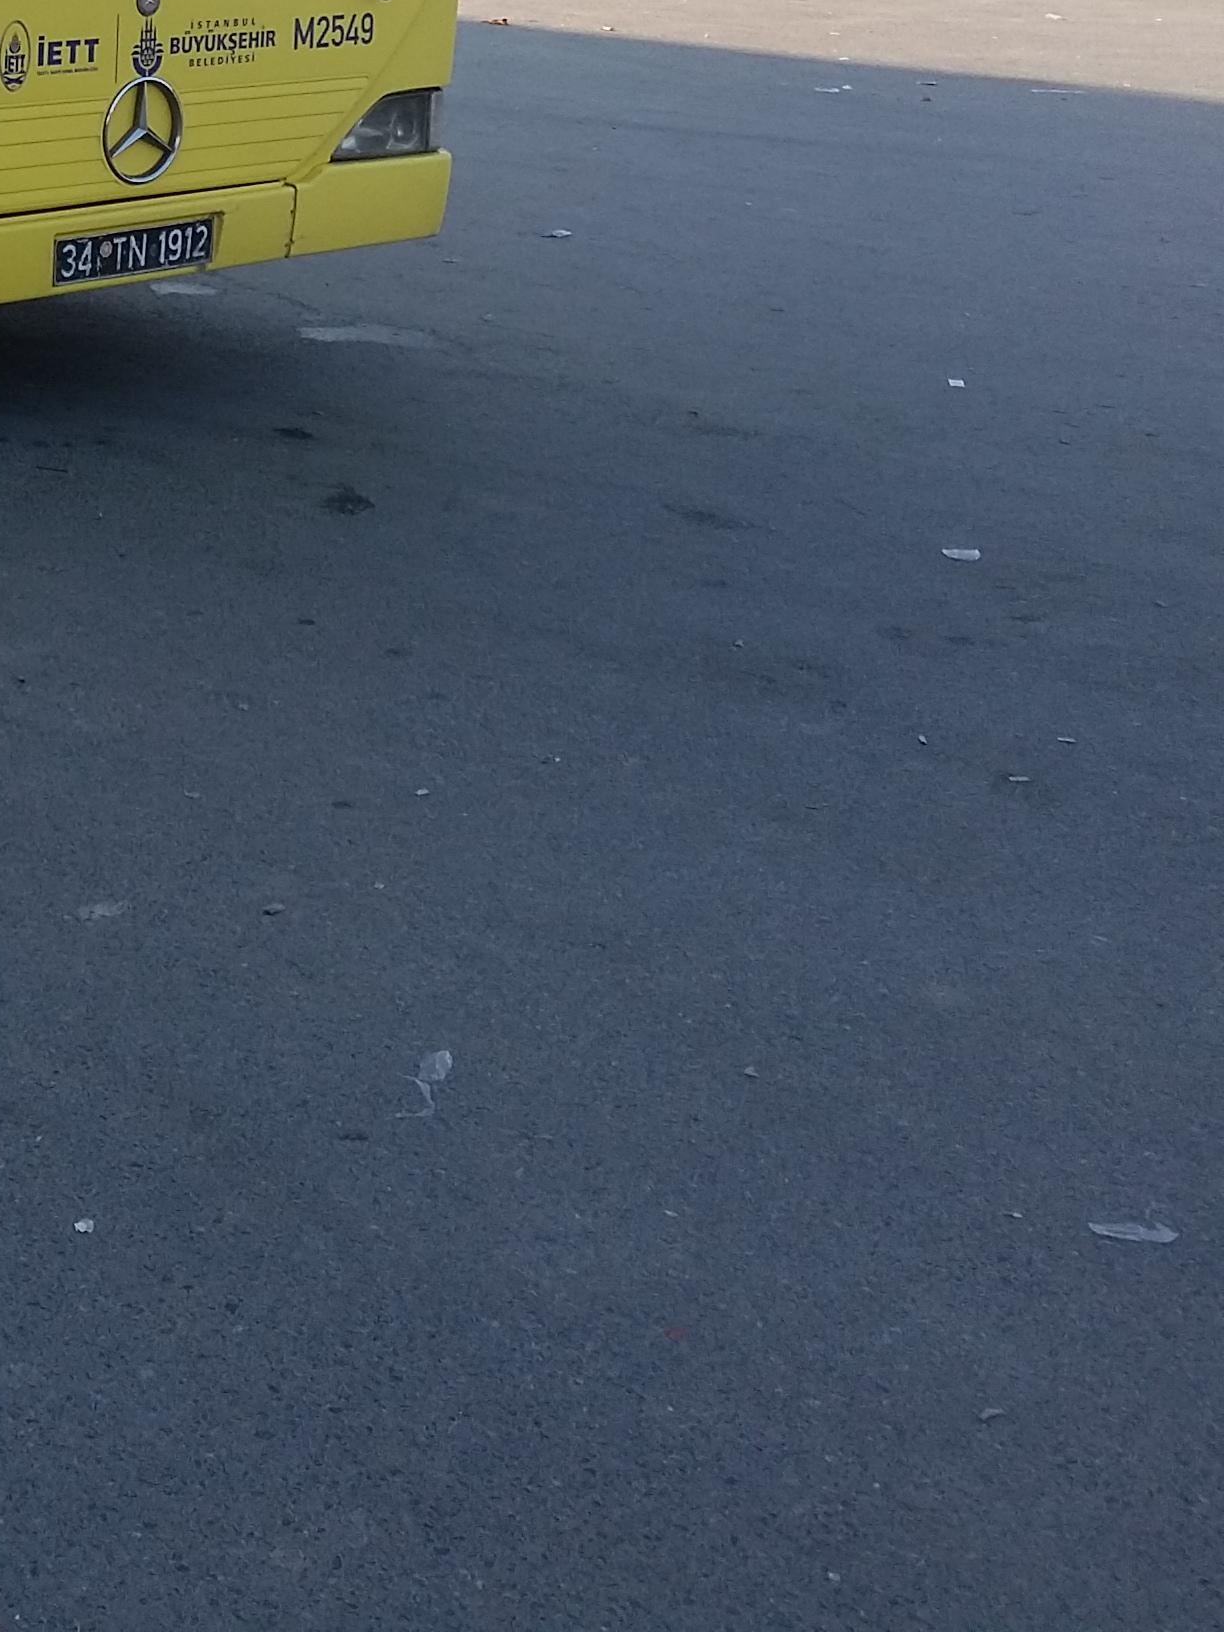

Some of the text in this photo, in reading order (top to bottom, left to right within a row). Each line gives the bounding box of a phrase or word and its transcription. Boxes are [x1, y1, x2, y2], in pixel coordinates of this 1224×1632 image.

[189, 17, 256, 30] İSTANBUL
[293, 12, 374, 50] M2549
[37, 35, 100, 67] İETT
[169, 25, 277, 55] BÜYÜKŞEHİR
[188, 52, 256, 68] BELEDİYESİ
[61, 225, 209, 278] 34 TN 1912
